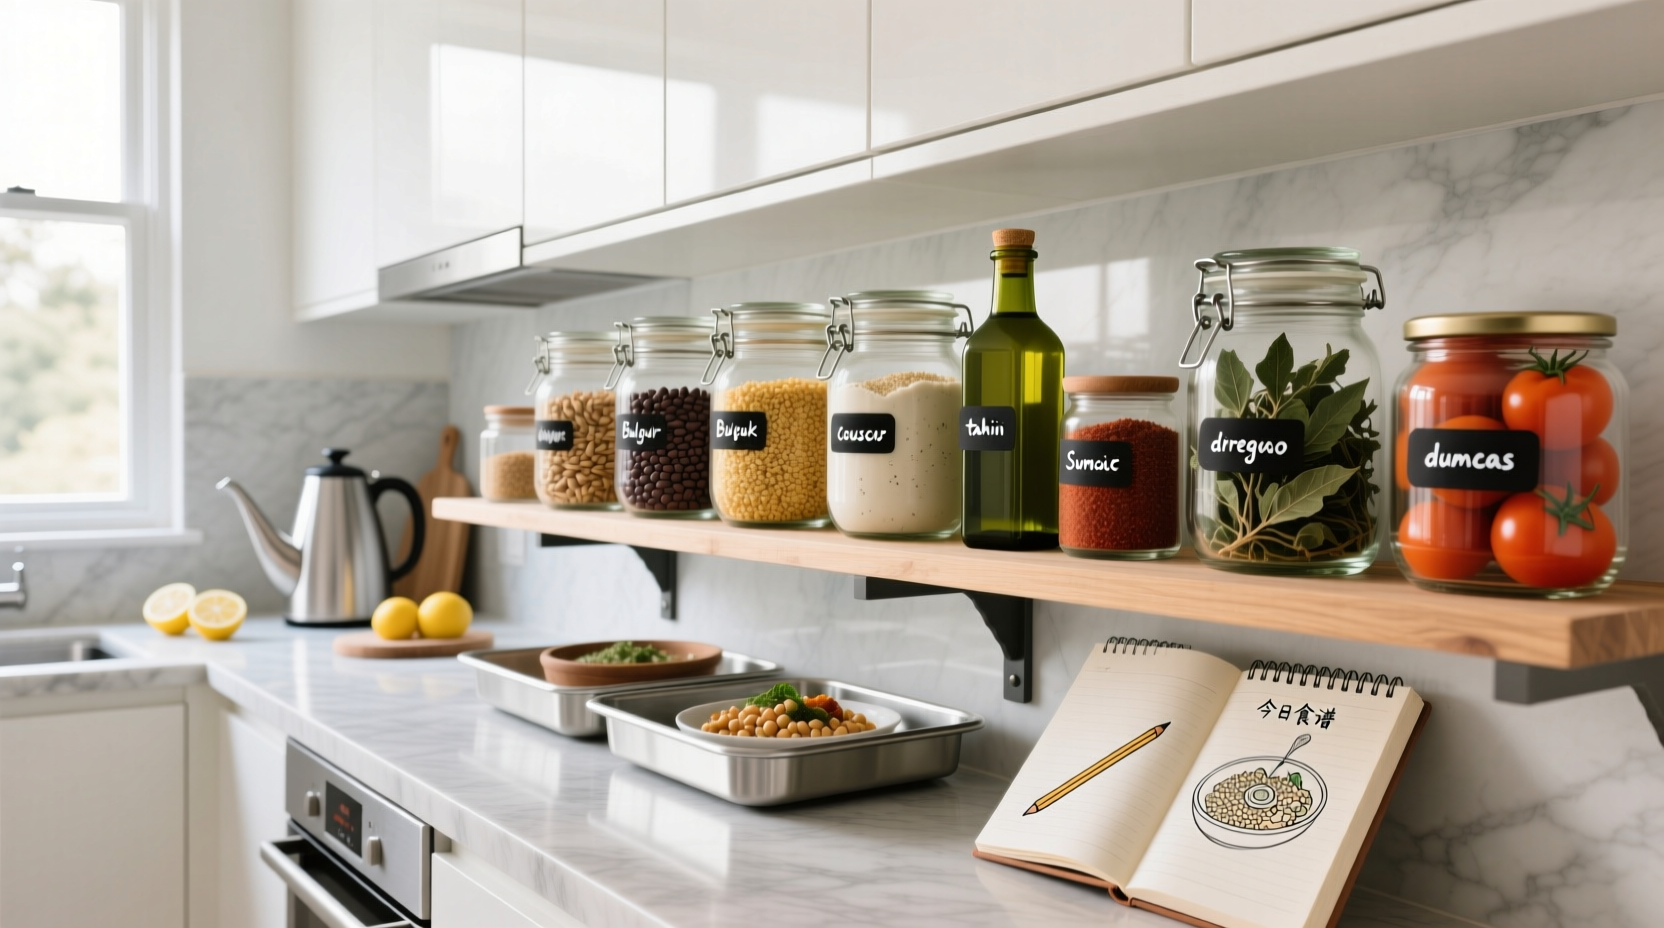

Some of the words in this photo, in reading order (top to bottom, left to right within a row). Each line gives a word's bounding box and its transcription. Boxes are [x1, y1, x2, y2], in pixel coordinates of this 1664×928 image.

[1424, 441, 1515, 471] dumcas
[1257, 698, 1336, 730] 今日食谱
